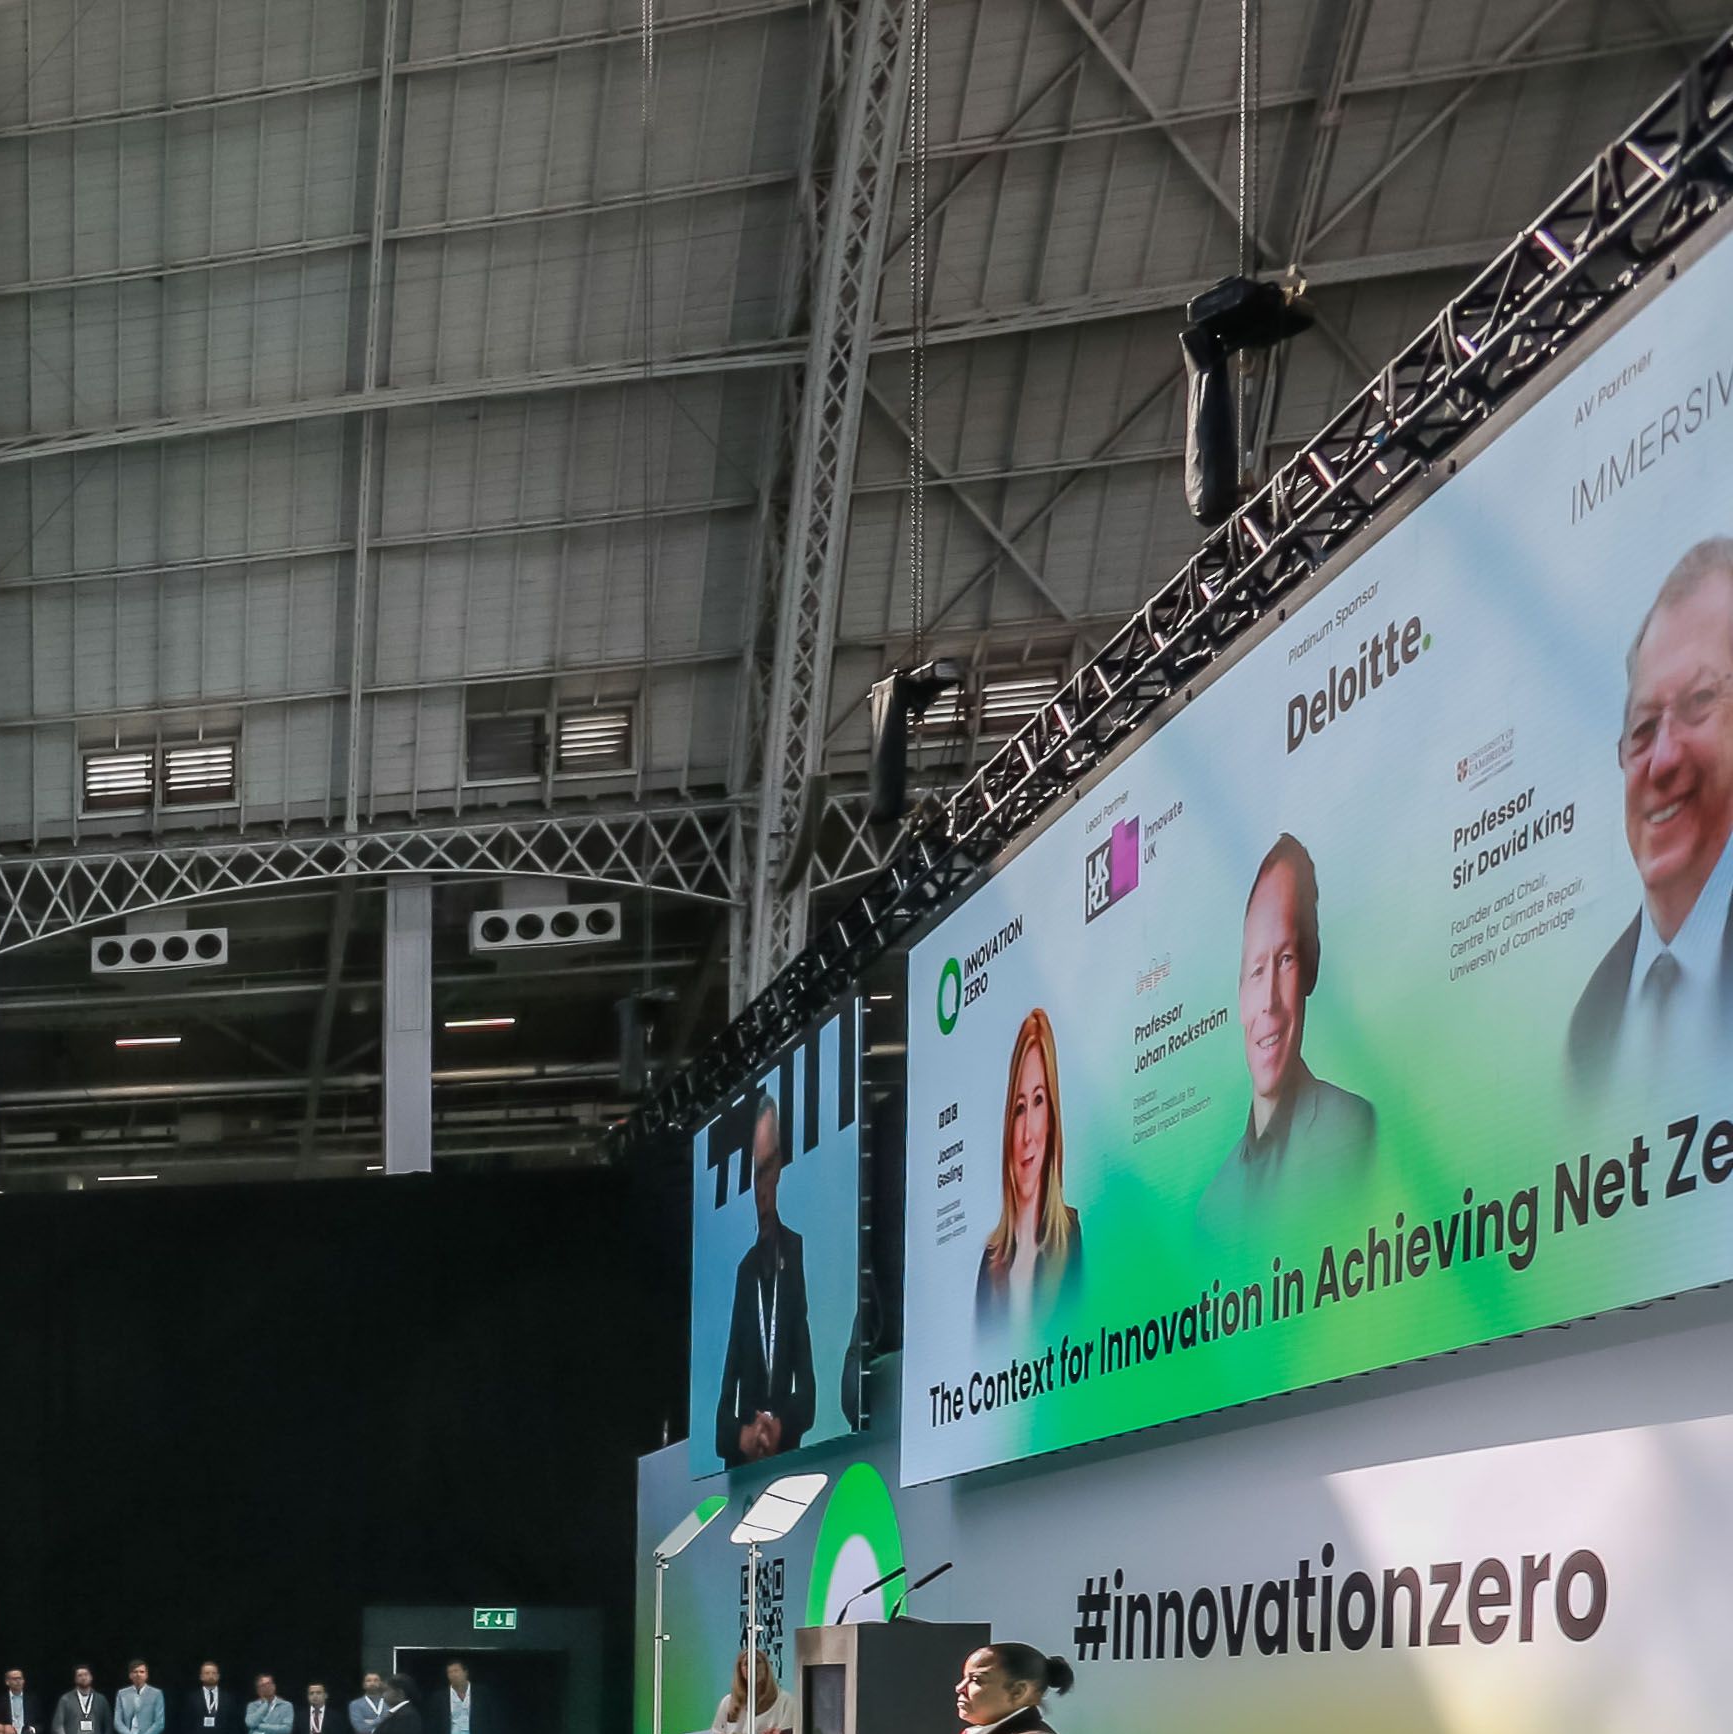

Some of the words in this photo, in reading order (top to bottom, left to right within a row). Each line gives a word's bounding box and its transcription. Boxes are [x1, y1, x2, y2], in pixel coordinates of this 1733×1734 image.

[1575, 395, 1594, 428] AV
[1597, 348, 1653, 408] Partner
[1288, 620, 1333, 665] Platinum
[1335, 580, 1380, 628] Sponsor
[1144, 801, 1183, 841] Innovate
[1452, 860, 1474, 890] Sir
[1477, 823, 1528, 877] David
[1532, 802, 1575, 845] King
[1453, 786, 1535, 852] Professor
[1144, 841, 1157, 864] UK
[1449, 947, 1498, 982] University
[1499, 937, 1510, 957] of
[1512, 907, 1575, 950] Cambridge
[1450, 932, 1484, 959] Centre
[1486, 922, 1500, 941] for
[1501, 898, 1544, 932] Climate
[1451, 904, 1492, 937] Founder
[1493, 888, 1515, 913] and
[964, 914, 1023, 980] INNOVATION
[964, 972, 988, 1008] ZERO
[1135, 1003, 1184, 1045] Professor
[1135, 1043, 1166, 1074] Johan
[1168, 1007, 1228, 1056] Rockström
[929, 1380, 964, 1428] The
[969, 1345, 1054, 1415] Context
[1060, 1334, 1094, 1387] for
[1100, 1279, 1262, 1376] Innovation
[1272, 1256, 1304, 1323] in
[1314, 1185, 1538, 1309] Achieving
[1554, 1135, 1650, 1234] Net
[1073, 1541, 1607, 1661] #innovationzero
